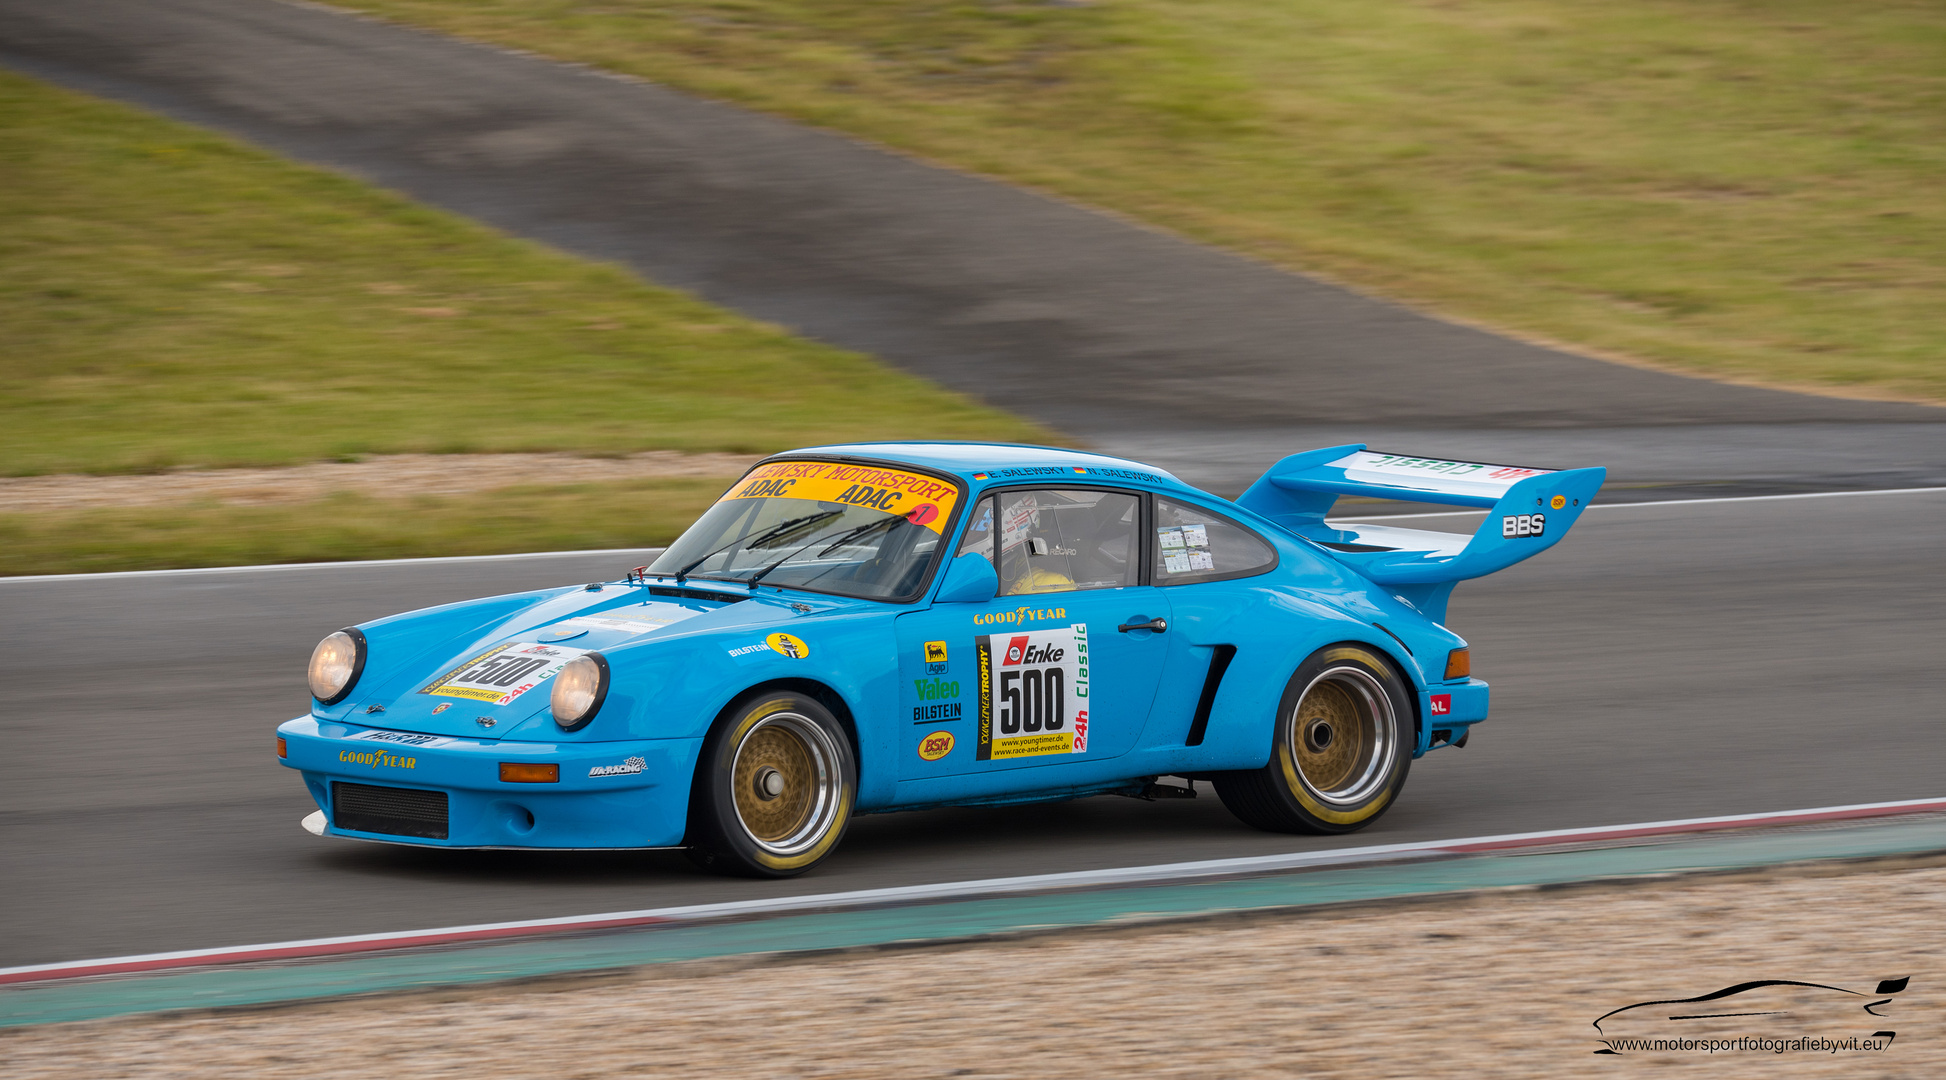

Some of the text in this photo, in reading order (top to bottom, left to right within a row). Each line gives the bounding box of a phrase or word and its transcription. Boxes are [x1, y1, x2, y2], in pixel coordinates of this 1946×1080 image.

[1003, 466, 1066, 477] SALEWSKY
[1367, 455, 1484, 475] Classic
[824, 465, 957, 502] MOTORSPORT
[1101, 468, 1164, 485] SALEWSKY
[736, 478, 797, 498] ADAC
[834, 483, 903, 510] ADAC
[914, 505, 931, 522] 1
[1502, 513, 1546, 539] BBS
[728, 643, 771, 658] BILSTEIN
[1022, 642, 1065, 665] Enke
[457, 654, 551, 687] 500
[928, 663, 946, 674] Agip
[435, 687, 500, 700] youngtimer.de
[499, 682, 534, 705] 24h
[913, 677, 960, 701] Valeo
[1074, 624, 1089, 752] 24h Classic
[1000, 667, 1064, 735] 500
[913, 702, 962, 721] BILSTEIN
[923, 736, 951, 752] BSM
[993, 742, 1070, 756] www.race-and-events.de
[1001, 735, 1064, 747] www.youngtimer.de
